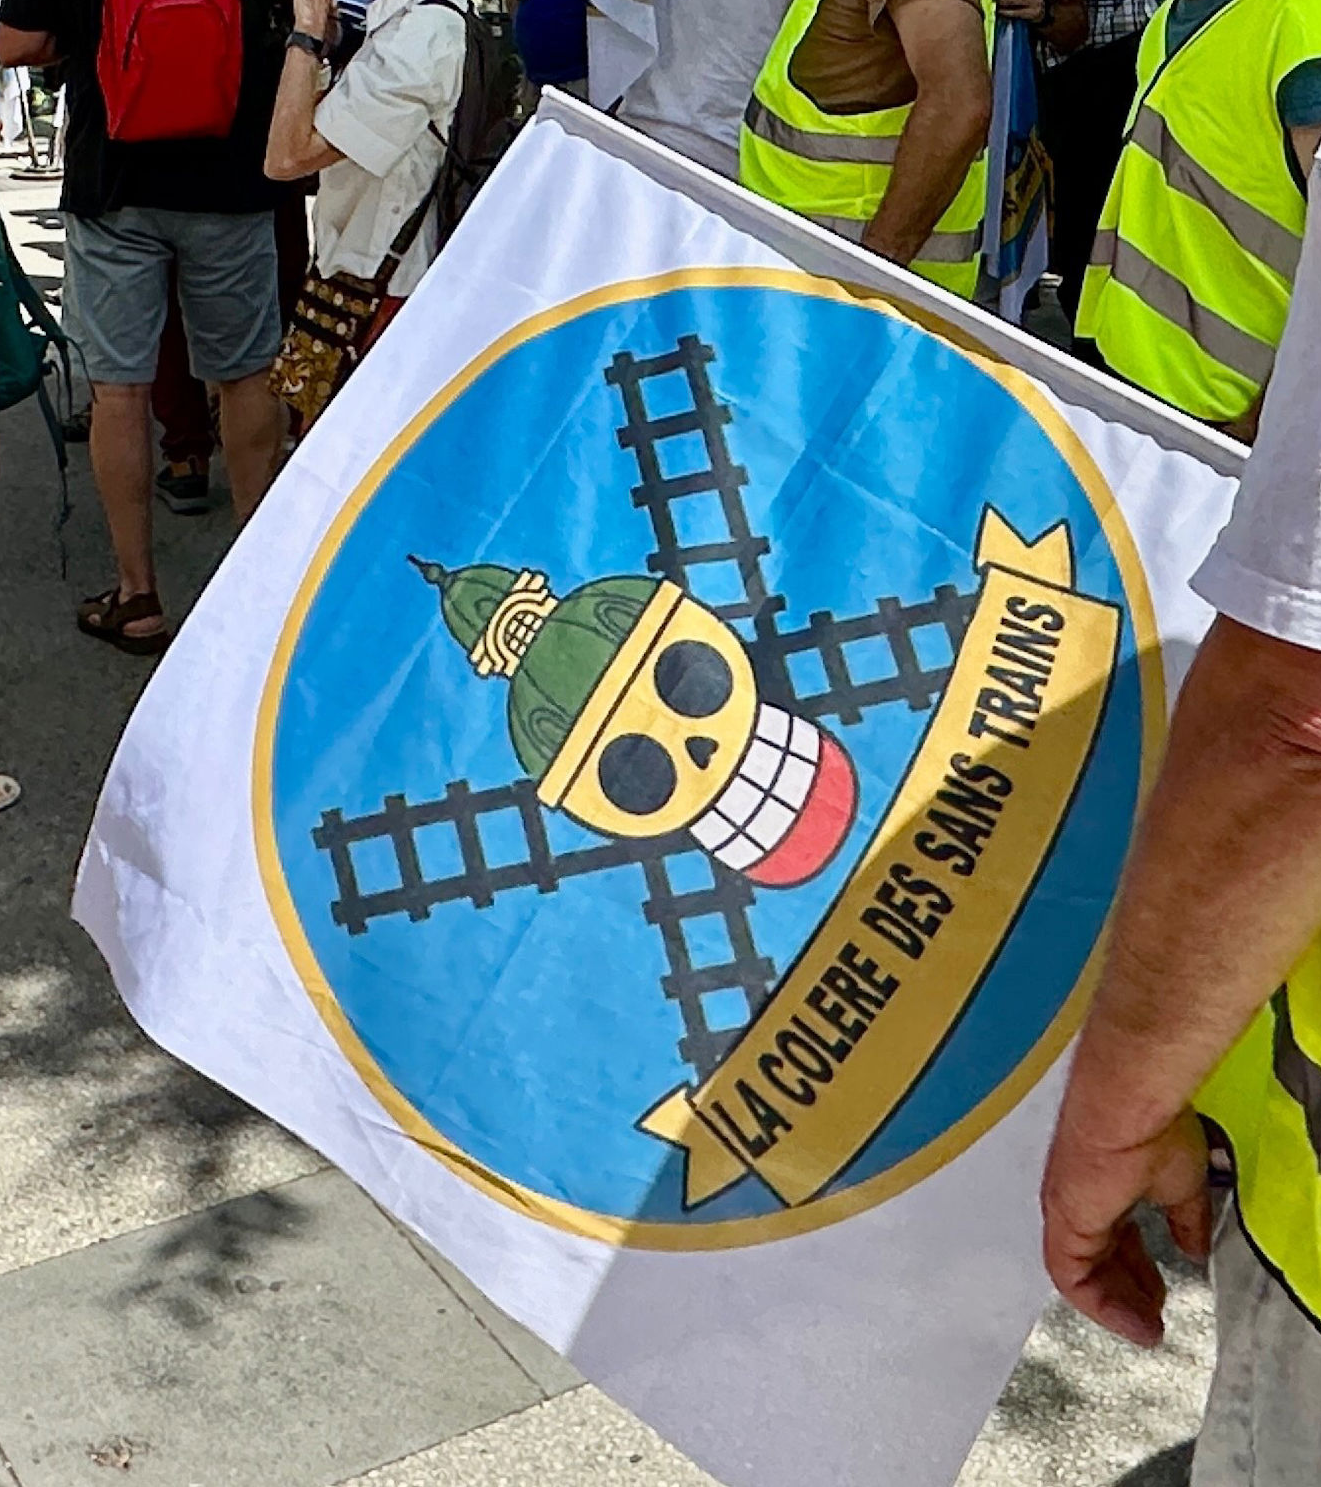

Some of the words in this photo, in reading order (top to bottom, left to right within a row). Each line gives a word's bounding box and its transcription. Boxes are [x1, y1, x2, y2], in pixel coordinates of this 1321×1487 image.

[712, 1079, 793, 1161] LA
[758, 940, 900, 1108] COLERE
[860, 861, 955, 961] DES
[913, 753, 1014, 878] SANS
[969, 596, 1066, 751] TRAINS
